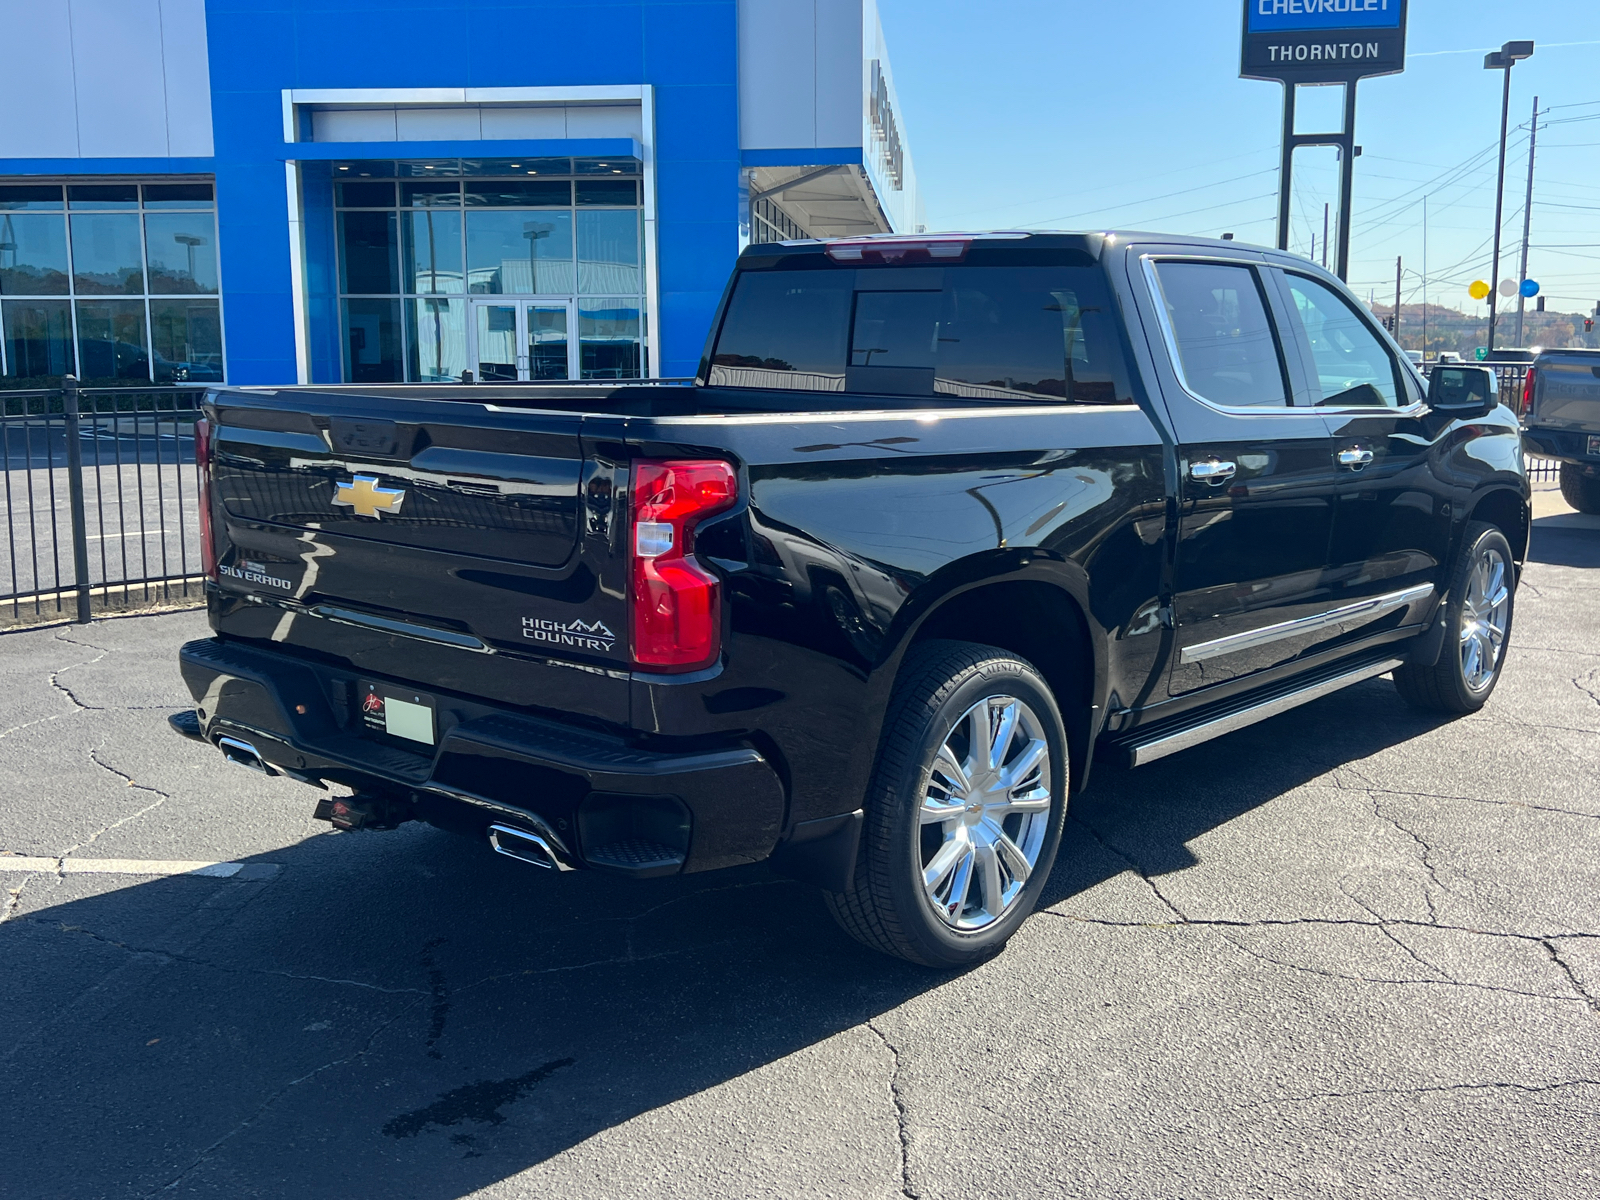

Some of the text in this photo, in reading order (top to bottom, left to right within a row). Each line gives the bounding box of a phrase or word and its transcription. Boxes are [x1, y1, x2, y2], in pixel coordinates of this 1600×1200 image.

[1258, 0, 1387, 14] CHEVROLET
[1268, 42, 1378, 61] THORNTON
[219, 564, 291, 590] SILVERADO
[521, 616, 566, 632] HIGH
[522, 628, 615, 652] COUNTRY
[985, 663, 1018, 675] ALENZA
